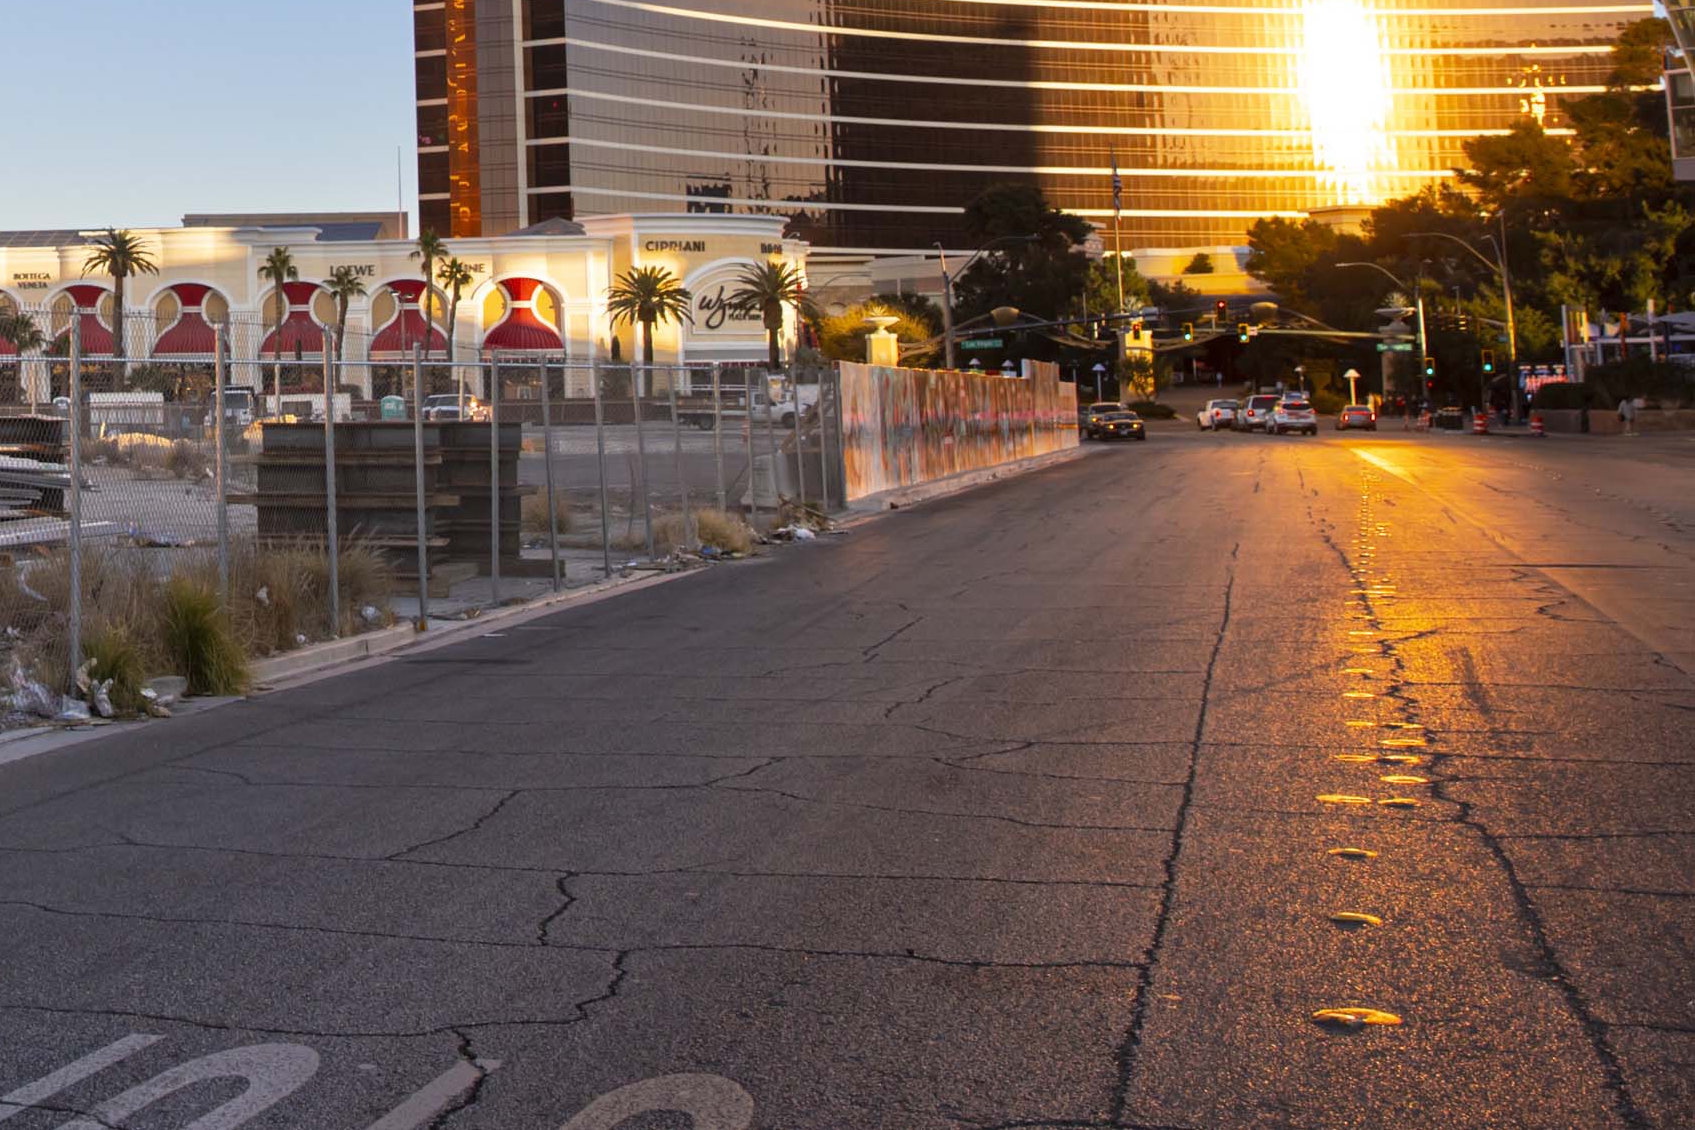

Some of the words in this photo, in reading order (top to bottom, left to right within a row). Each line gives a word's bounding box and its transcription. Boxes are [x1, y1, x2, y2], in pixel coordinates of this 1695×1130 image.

[645, 240, 706, 252] CIPRIANI
[330, 264, 376, 277] LOEWE
[13, 272, 51, 280] BOTTEGA
[17, 281, 48, 289] VENETA
